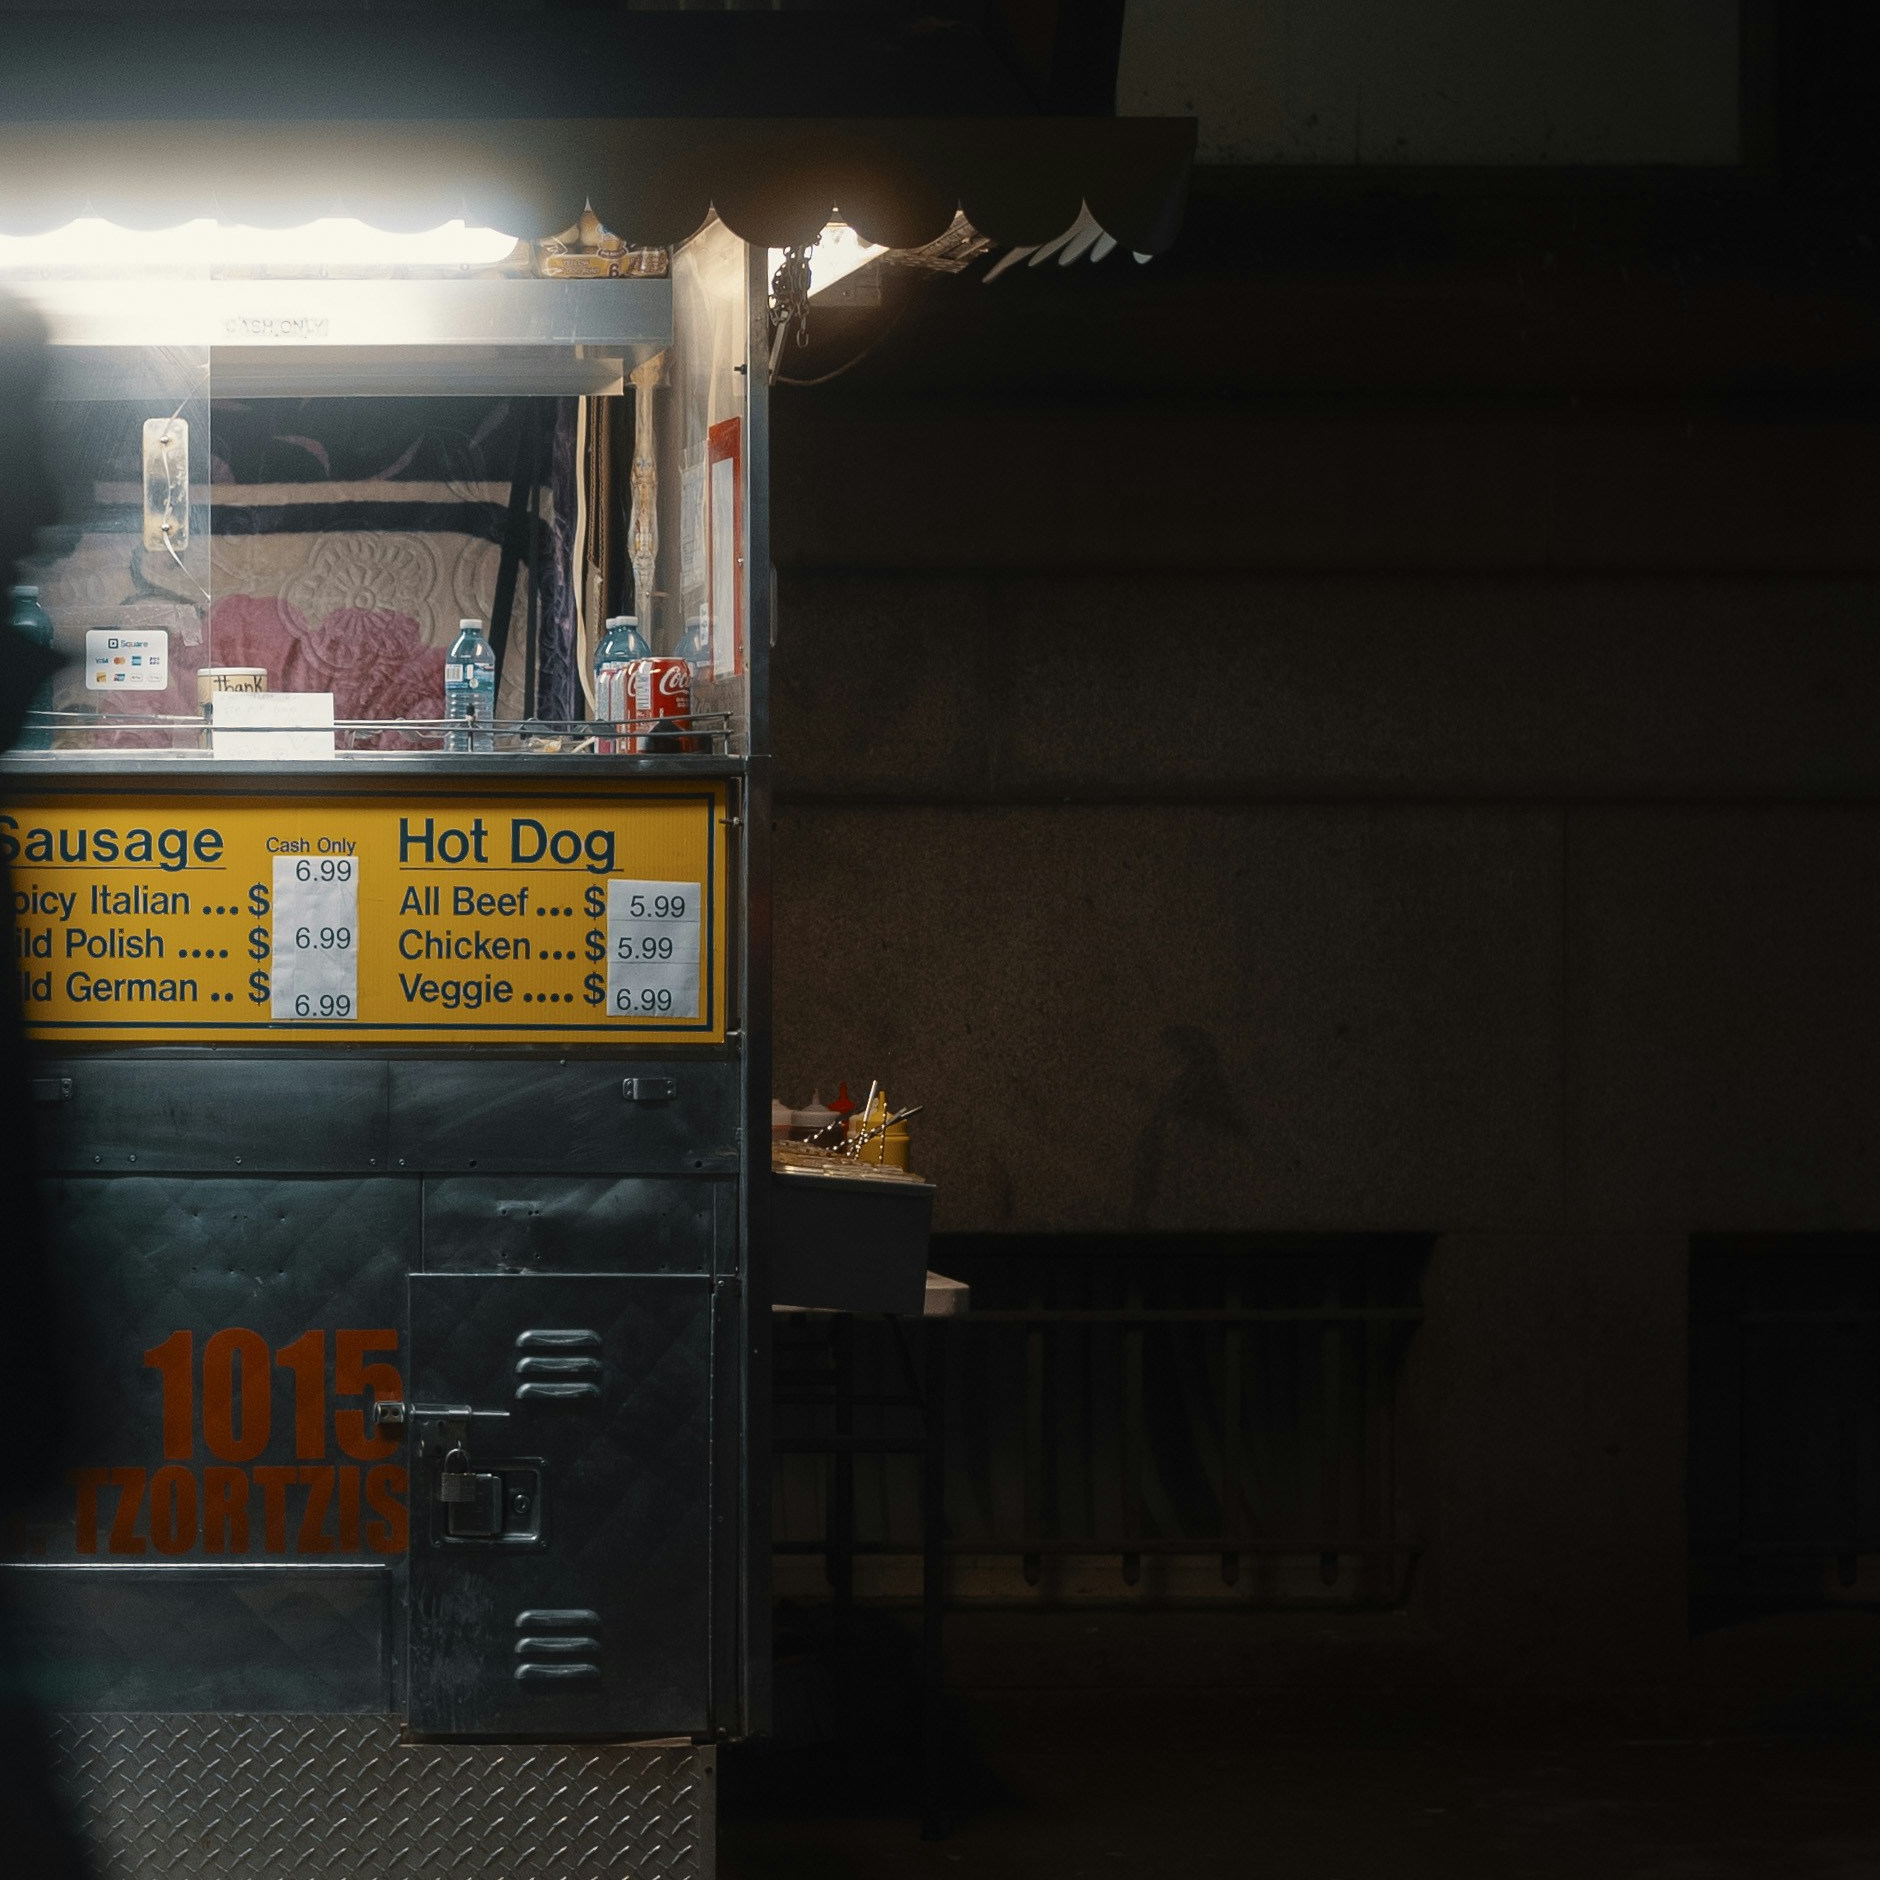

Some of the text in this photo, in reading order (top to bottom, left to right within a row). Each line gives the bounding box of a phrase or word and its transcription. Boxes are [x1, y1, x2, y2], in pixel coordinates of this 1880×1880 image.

[280, 319, 325, 333] ONLY
[120, 639, 149, 650] Square
[265, 836, 357, 857] Cash Only
[399, 816, 616, 875] Hot Dog
[295, 859, 352, 883] 6.99
[11, 884, 78, 922] picy
[90, 884, 190, 916] Italian
[399, 885, 440, 916] All
[452, 885, 529, 916] Beef
[629, 894, 686, 919] 5.99
[16, 927, 52, 959] ild
[66, 927, 165, 959] Polish
[295, 926, 352, 950] 6.99
[398, 928, 531, 960] Chicken
[617, 936, 673, 960] 5.99
[65, 971, 198, 1003] German
[398, 972, 514, 1009] Veggie
[616, 988, 672, 1011] 6.99
[294, 994, 351, 1018] 6.99
[143, 1326, 404, 1462] 1015
[65, 1464, 410, 1555] TZORTZIS
